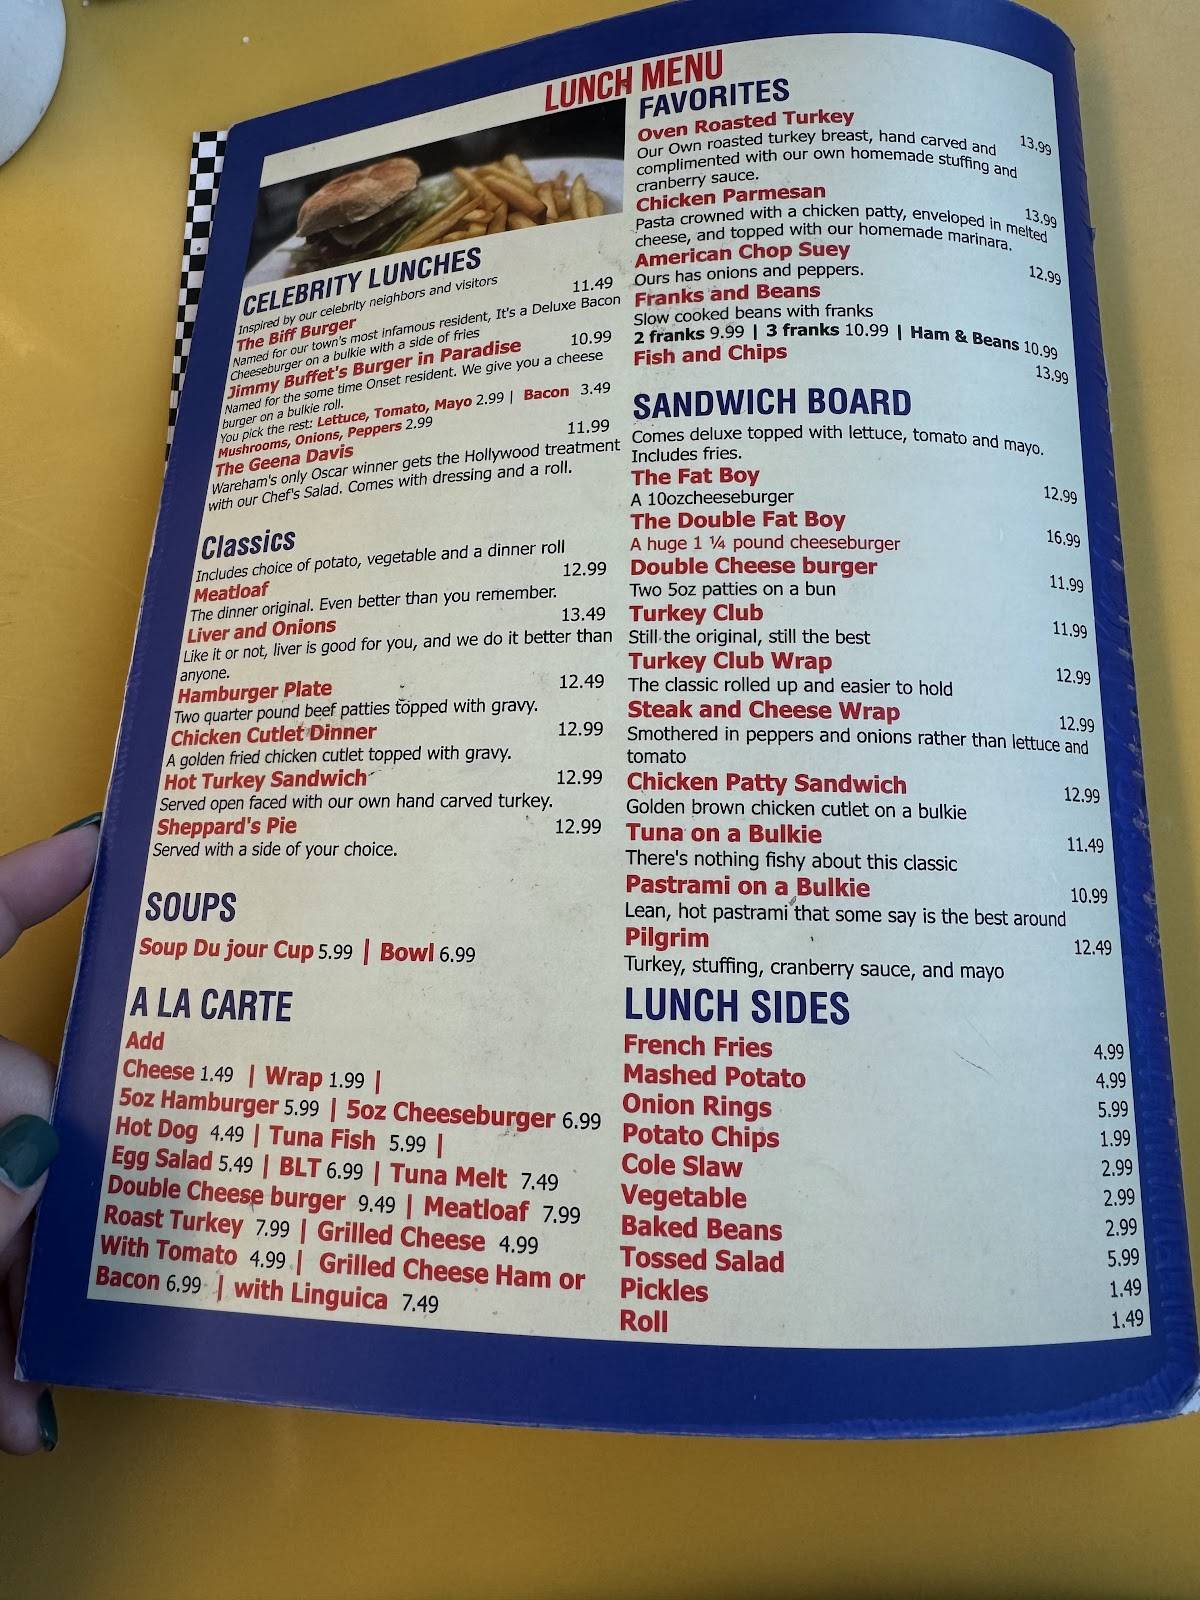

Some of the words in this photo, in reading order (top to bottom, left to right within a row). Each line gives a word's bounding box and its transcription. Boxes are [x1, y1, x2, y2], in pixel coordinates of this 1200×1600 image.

[545, 66, 633, 112] LUNCH
[641, 49, 723, 92] MENU
[639, 77, 790, 120] FAVORITES
[637, 125, 688, 142] Oven
[694, 111, 777, 134] Roasted
[782, 108, 855, 127] Turkey
[637, 147, 664, 159] Our
[668, 141, 702, 155] Own
[707, 132, 763, 150] roasted
[768, 130, 817, 145] turkey
[821, 128, 873, 145] breast,
[879, 129, 916, 144] hand
[920, 135, 967, 151] carved
[971, 142, 997, 157] and
[1020, 135, 1052, 156] 13.99
[636, 175, 707, 193] cranberry
[711, 170, 759, 184] sauce.
[636, 192, 716, 212] Chicken
[723, 186, 826, 204] Parmesan
[1025, 208, 1057, 229] 13.99
[634, 247, 732, 269] American
[738, 243, 793, 261] Chop
[798, 241, 851, 261] Suey
[242, 270, 363, 317] CELEBRITY
[368, 246, 482, 289] LUNCHES
[573, 276, 613, 293] 11.49
[632, 273, 670, 287] Ours
[675, 269, 702, 283] has
[706, 266, 758, 281] onions
[762, 262, 792, 278] and
[797, 265, 864, 280] peppers.
[1029, 265, 1062, 286] 12.99
[238, 316, 280, 336] Inspired
[282, 315, 296, 327] by
[298, 310, 318, 322] our
[320, 300, 367, 317] celebrity
[369, 289, 426, 307] neighbors
[429, 281, 452, 296] and
[455, 276, 498, 291] visitors
[571, 330, 612, 346] 10.99
[230, 359, 304, 382] Cheeseburger
[305, 356, 320, 367] on
[322, 354, 330, 363] a
[333, 346, 366, 361] bulkie
[370, 341, 394, 355] with
[397, 341, 406, 350] a
[409, 334, 434, 348] side
[437, 330, 451, 344] of
[453, 328, 480, 341] fries
[634, 348, 676, 366] Fish
[681, 345, 721, 363] and
[728, 343, 788, 364] Chips
[1035, 364, 1069, 385] 13.99
[633, 387, 796, 420] SANDWICH
[808, 387, 912, 416] BOARD
[567, 418, 610, 435] 11.99
[215, 461, 245, 478] The
[248, 454, 301, 472] Geena
[305, 443, 354, 464] Davis
[631, 447, 698, 463] Includes
[702, 446, 742, 460] fries.
[630, 468, 672, 486] The
[678, 467, 713, 485] Fat
[719, 467, 760, 487] Boy
[630, 493, 642, 507] A
[648, 489, 795, 507] 10ozcheeseburger
[1044, 485, 1078, 505] 12.99
[201, 529, 296, 560] Classics
[630, 537, 642, 551] A
[647, 536, 688, 554] huge
[694, 535, 702, 550] 1
[709, 535, 726, 550] ¼
[733, 534, 784, 553] pound
[790, 534, 901, 554] cheeseburger
[1046, 529, 1081, 548] 16.99
[563, 561, 607, 577] 12.99
[190, 608, 214, 622] The
[217, 606, 259, 620] dinner
[261, 598, 314, 618] original.
[319, 597, 353, 611] Even
[357, 593, 401, 608] better
[405, 590, 438, 606] than
[443, 591, 470, 607] you
[476, 584, 557, 602] remember.
[193, 580, 271, 603] Meatloaf
[562, 606, 606, 622] 13.49
[187, 627, 231, 644] Liver
[233, 621, 268, 640] and
[272, 618, 337, 637] Onions
[628, 651, 707, 674] Turkey
[713, 651, 764, 670] Club
[770, 651, 833, 674] Wrap
[180, 668, 230, 684] anyone.
[627, 676, 659, 692] The
[665, 676, 719, 692] classic
[724, 676, 770, 692] rolled
[777, 680, 798, 696] up
[803, 677, 835, 693] and
[840, 678, 891, 694] easier
[895, 680, 913, 695] to
[919, 679, 953, 697] hold
[1056, 667, 1091, 686] 12.99
[177, 685, 279, 704] Hamburger
[283, 680, 333, 698] Plate
[164, 773, 198, 791] Hot
[201, 771, 266, 793] Turkey
[270, 768, 368, 788] Sandwich
[557, 769, 603, 785] 12.99
[627, 771, 718, 791] Chicken
[726, 772, 788, 796] Patty
[794, 773, 907, 795] Sandwich
[626, 798, 685, 815] Golden
[692, 798, 745, 815] brown
[751, 799, 815, 816] chicken
[821, 800, 870, 818] cutlet
[874, 805, 896, 818] on
[902, 806, 912, 819] a
[918, 802, 967, 821] bulkie
[145, 891, 237, 923] SOUPS
[139, 937, 188, 961] Soup
[193, 938, 221, 957] Du
[223, 938, 269, 962] jour
[273, 939, 314, 964] Cup
[318, 943, 353, 960] 5.99
[623, 954, 686, 977] Turkey,
[692, 956, 764, 979] stuffing,
[770, 958, 855, 980] cranberry
[860, 963, 916, 981] sauce,
[922, 961, 954, 979] and
[960, 965, 1005, 983] mayo
[129, 986, 148, 1017] A
[157, 987, 191, 1019] LA
[201, 988, 293, 1022] CARTE
[625, 986, 738, 1023] LUNCH
[751, 989, 850, 1026] SIDES
[624, 1033, 706, 1056] French
[714, 1036, 773, 1058] Fries
[1093, 1043, 1124, 1061] 4.99
[623, 1063, 717, 1086] Mashed
[725, 1066, 806, 1089] Potato
[620, 1183, 747, 1212] Vegetable
[1103, 1187, 1135, 1207] 2.99
[104, 1204, 165, 1229] Roast
[169, 1209, 244, 1240] Turkey
[256, 1218, 290, 1238] 7.99
[317, 1220, 393, 1246] Grilled
[400, 1225, 486, 1252] Cheese
[499, 1235, 539, 1255] 4.99
[620, 1277, 709, 1303] Pickles
[620, 1309, 668, 1333] Roll
